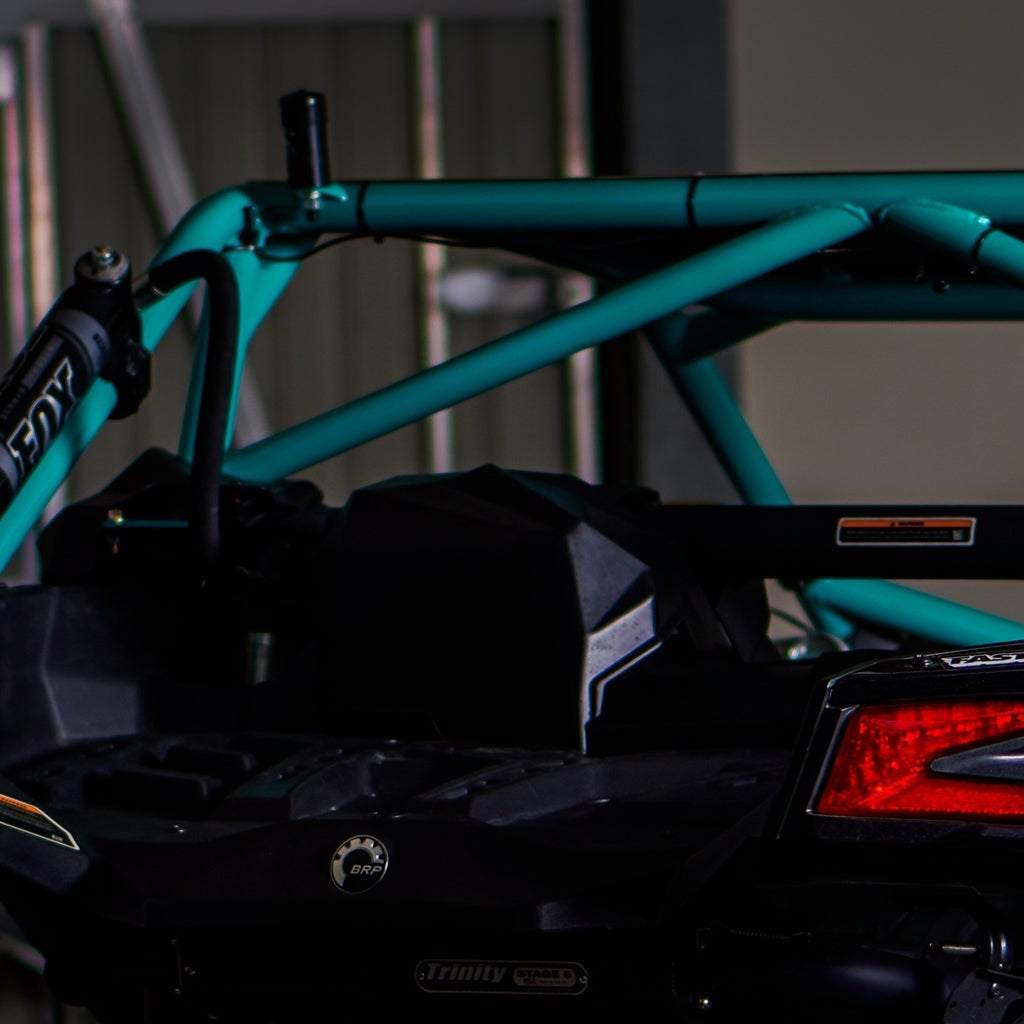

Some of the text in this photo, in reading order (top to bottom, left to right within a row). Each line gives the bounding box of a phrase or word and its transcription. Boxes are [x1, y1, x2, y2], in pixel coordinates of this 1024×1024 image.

[6, 355, 77, 481] FOX
[350, 864, 383, 875] BRP
[426, 963, 507, 984] Trinity
[517, 969, 560, 979] STAGE
